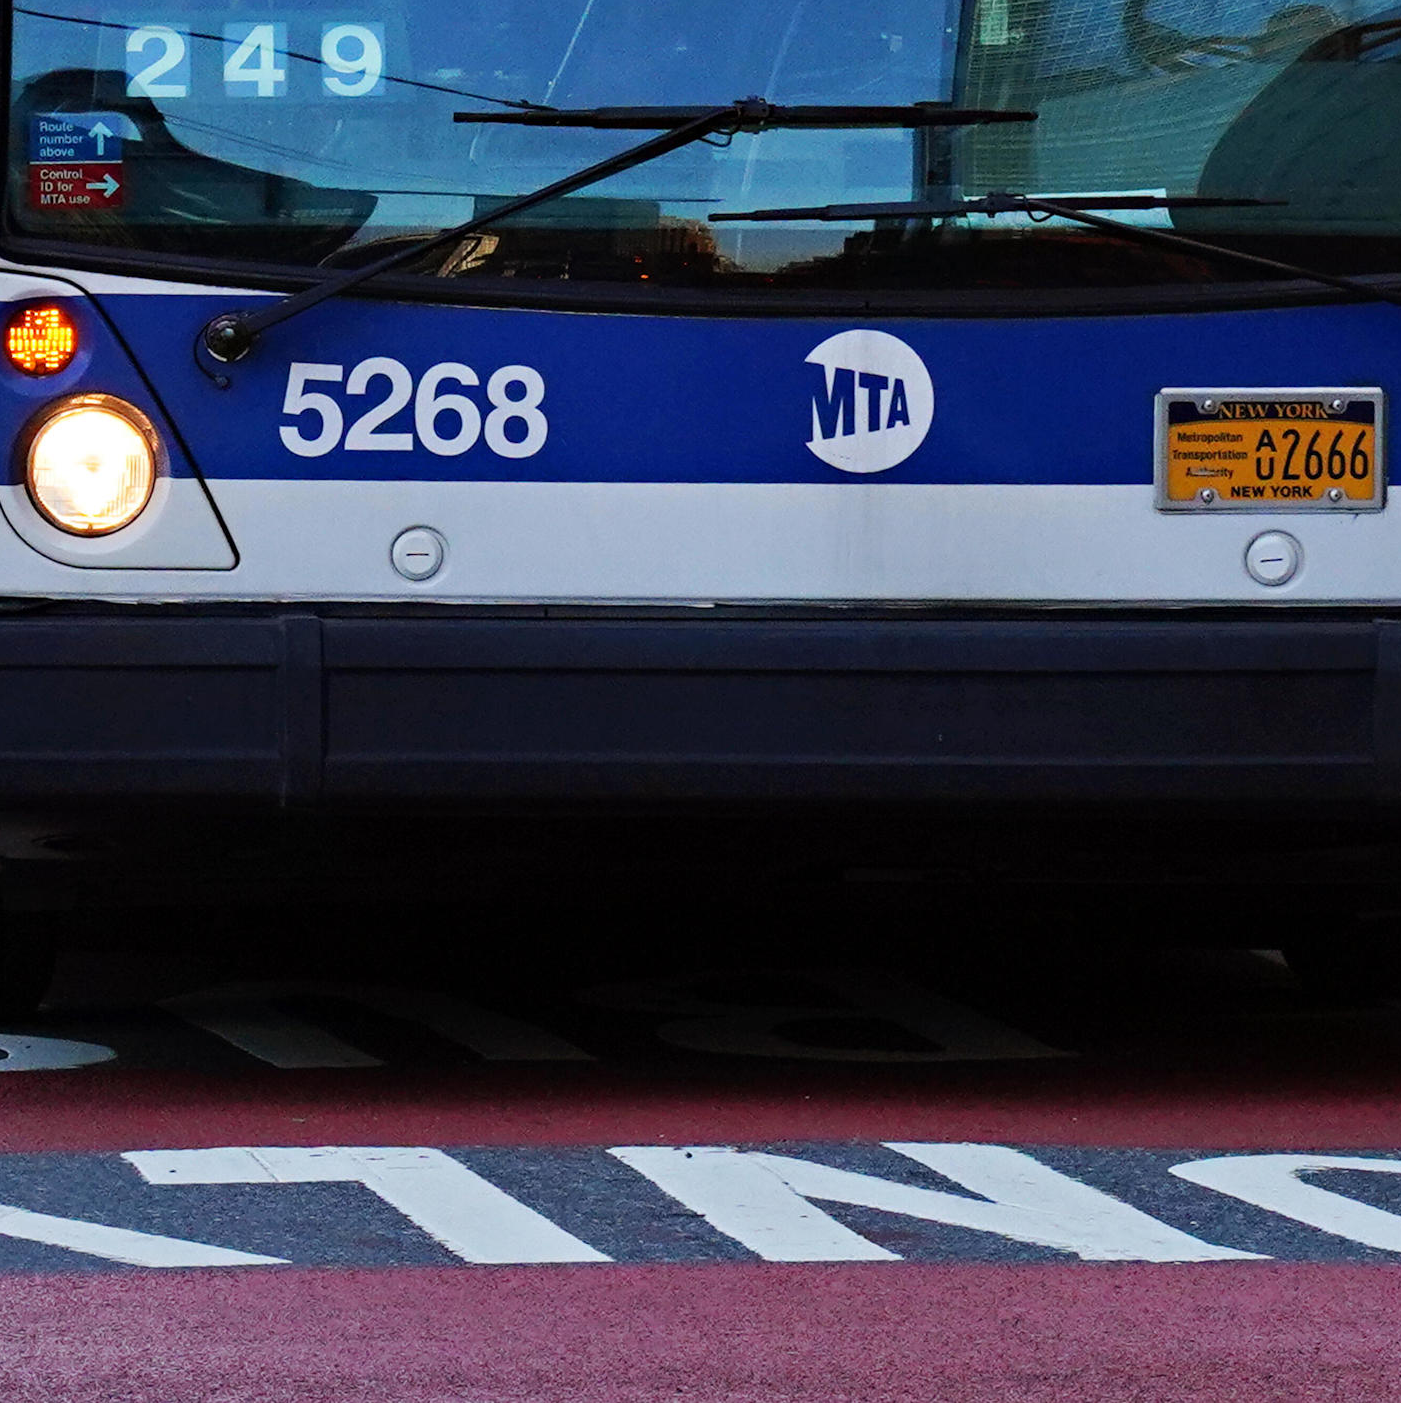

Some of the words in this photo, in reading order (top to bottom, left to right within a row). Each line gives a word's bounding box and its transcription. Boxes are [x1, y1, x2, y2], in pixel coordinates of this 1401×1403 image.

[39, 121, 74, 132] Route
[39, 135, 83, 145] number
[39, 147, 75, 158] above
[40, 169, 83, 180] Control
[40, 181, 54, 192] ID
[57, 181, 74, 192] for
[40, 194, 67, 205] MTA
[69, 196, 91, 204] use
[805, 361, 912, 442] MTA
[279, 356, 548, 459] 5268
[1218, 403, 1269, 419] NEW
[1274, 403, 1329, 420] YORK
[1177, 432, 1243, 444] Metropolitan
[1172, 449, 1248, 462] Transportation
[1230, 486, 1267, 498] NEW
[1271, 485, 1313, 499] YORK
